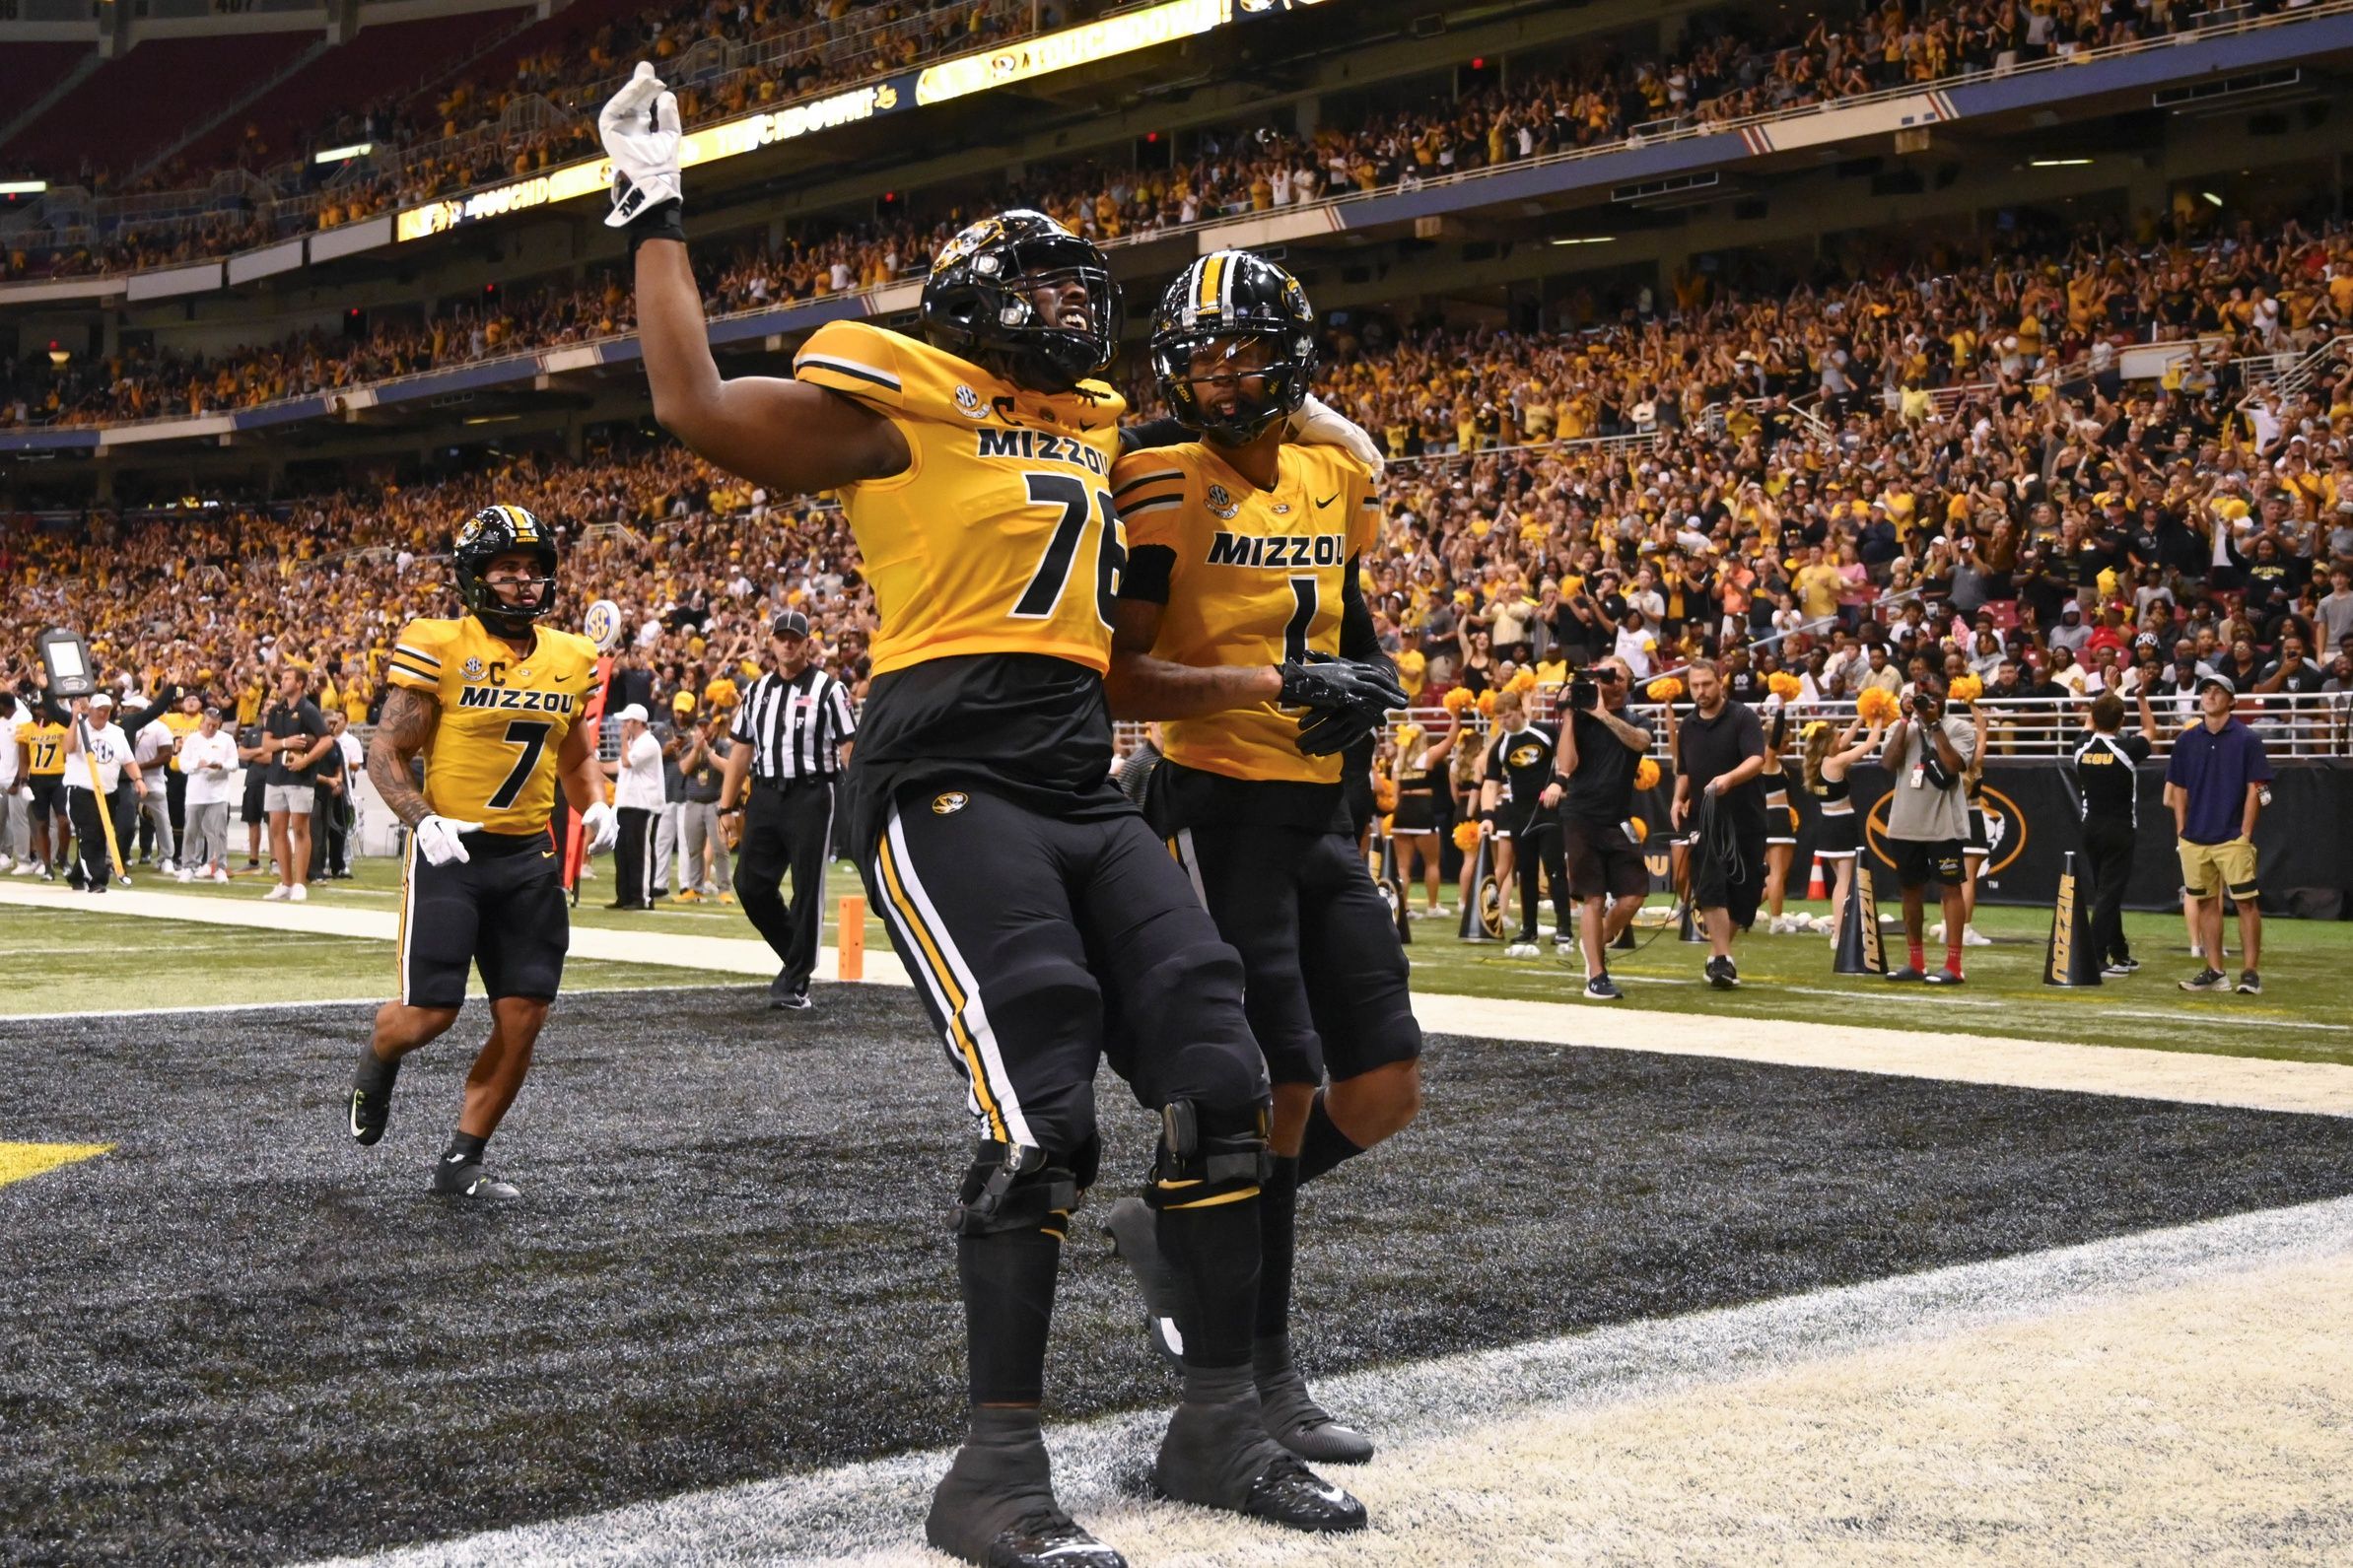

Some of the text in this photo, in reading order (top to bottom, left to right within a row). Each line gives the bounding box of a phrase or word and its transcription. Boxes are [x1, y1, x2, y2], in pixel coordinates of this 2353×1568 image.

[618, 187, 647, 219] NIKE
[955, 384, 977, 408] SEC
[992, 396, 1024, 427] C
[1209, 484, 1229, 506] SEC
[1006, 471, 1129, 634] 76
[1205, 531, 1347, 569] MIZZOU
[588, 605, 609, 643] SEC
[1279, 575, 1319, 713] 1
[465, 657, 482, 672] SEC
[489, 662, 506, 686] C
[457, 685, 576, 715] MIZZOU
[796, 717, 804, 729] F
[35, 743, 56, 769] 17
[483, 719, 554, 810] 7
[2081, 753, 2114, 765] ZOU
[1987, 880, 1999, 889] TM
[1857, 867, 1881, 972] MIZZOU
[2052, 874, 2075, 984] MIZZOU
